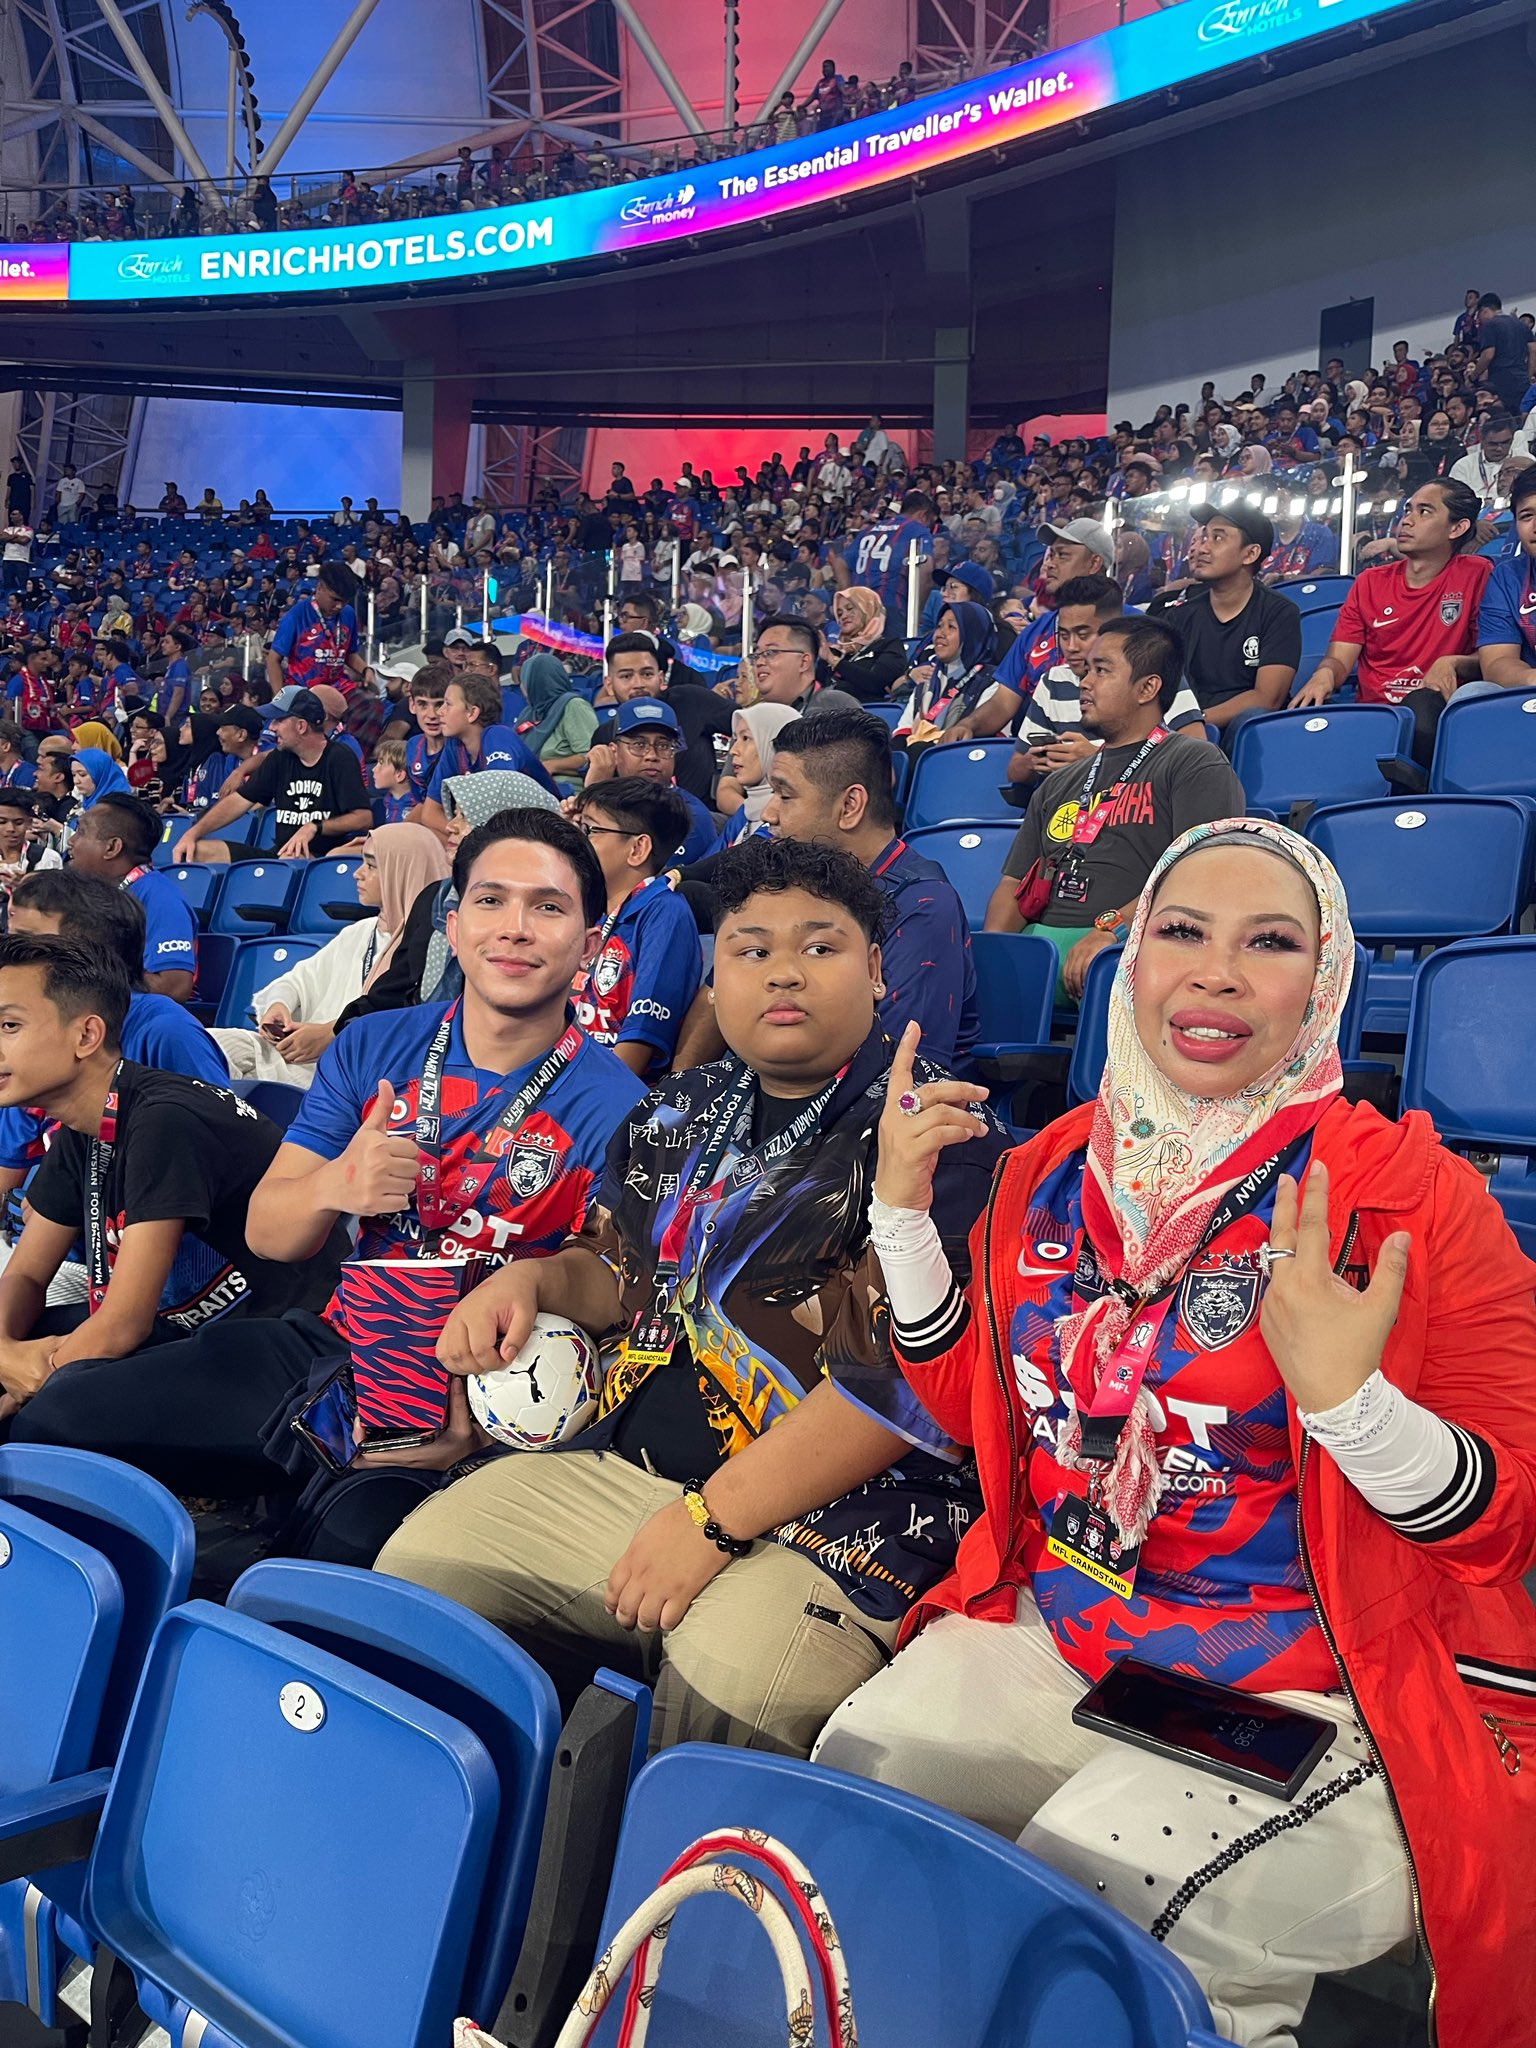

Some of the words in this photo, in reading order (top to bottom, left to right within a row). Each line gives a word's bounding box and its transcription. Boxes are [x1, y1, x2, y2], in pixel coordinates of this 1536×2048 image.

[1247, 6, 1303, 36] HOTELS
[718, 177, 759, 199] The
[763, 142, 859, 188] Essential
[866, 102, 983, 157] Traveller's
[988, 69, 1075, 116] Wallet.
[652, 206, 696, 225] money
[200, 216, 554, 281] ENRICHHOTELS.COM
[118, 253, 183, 279] Enrich
[152, 274, 191, 285] HOTELS
[856, 534, 892, 575] 84
[1406, 816, 1414, 825] 2
[157, 939, 192, 954] JCORP
[627, 998, 671, 1021] JCORP
[549, 1033, 577, 1070] KUALA
[705, 1093, 743, 1156] FOOTBALL
[439, 1233, 514, 1266] OKEN
[1108, 1379, 1130, 1395] MFL
[1052, 1543, 1069, 1559] MFL
[1070, 1555, 1127, 1593] GRANDSTAND
[294, 1694, 306, 1719] 2
